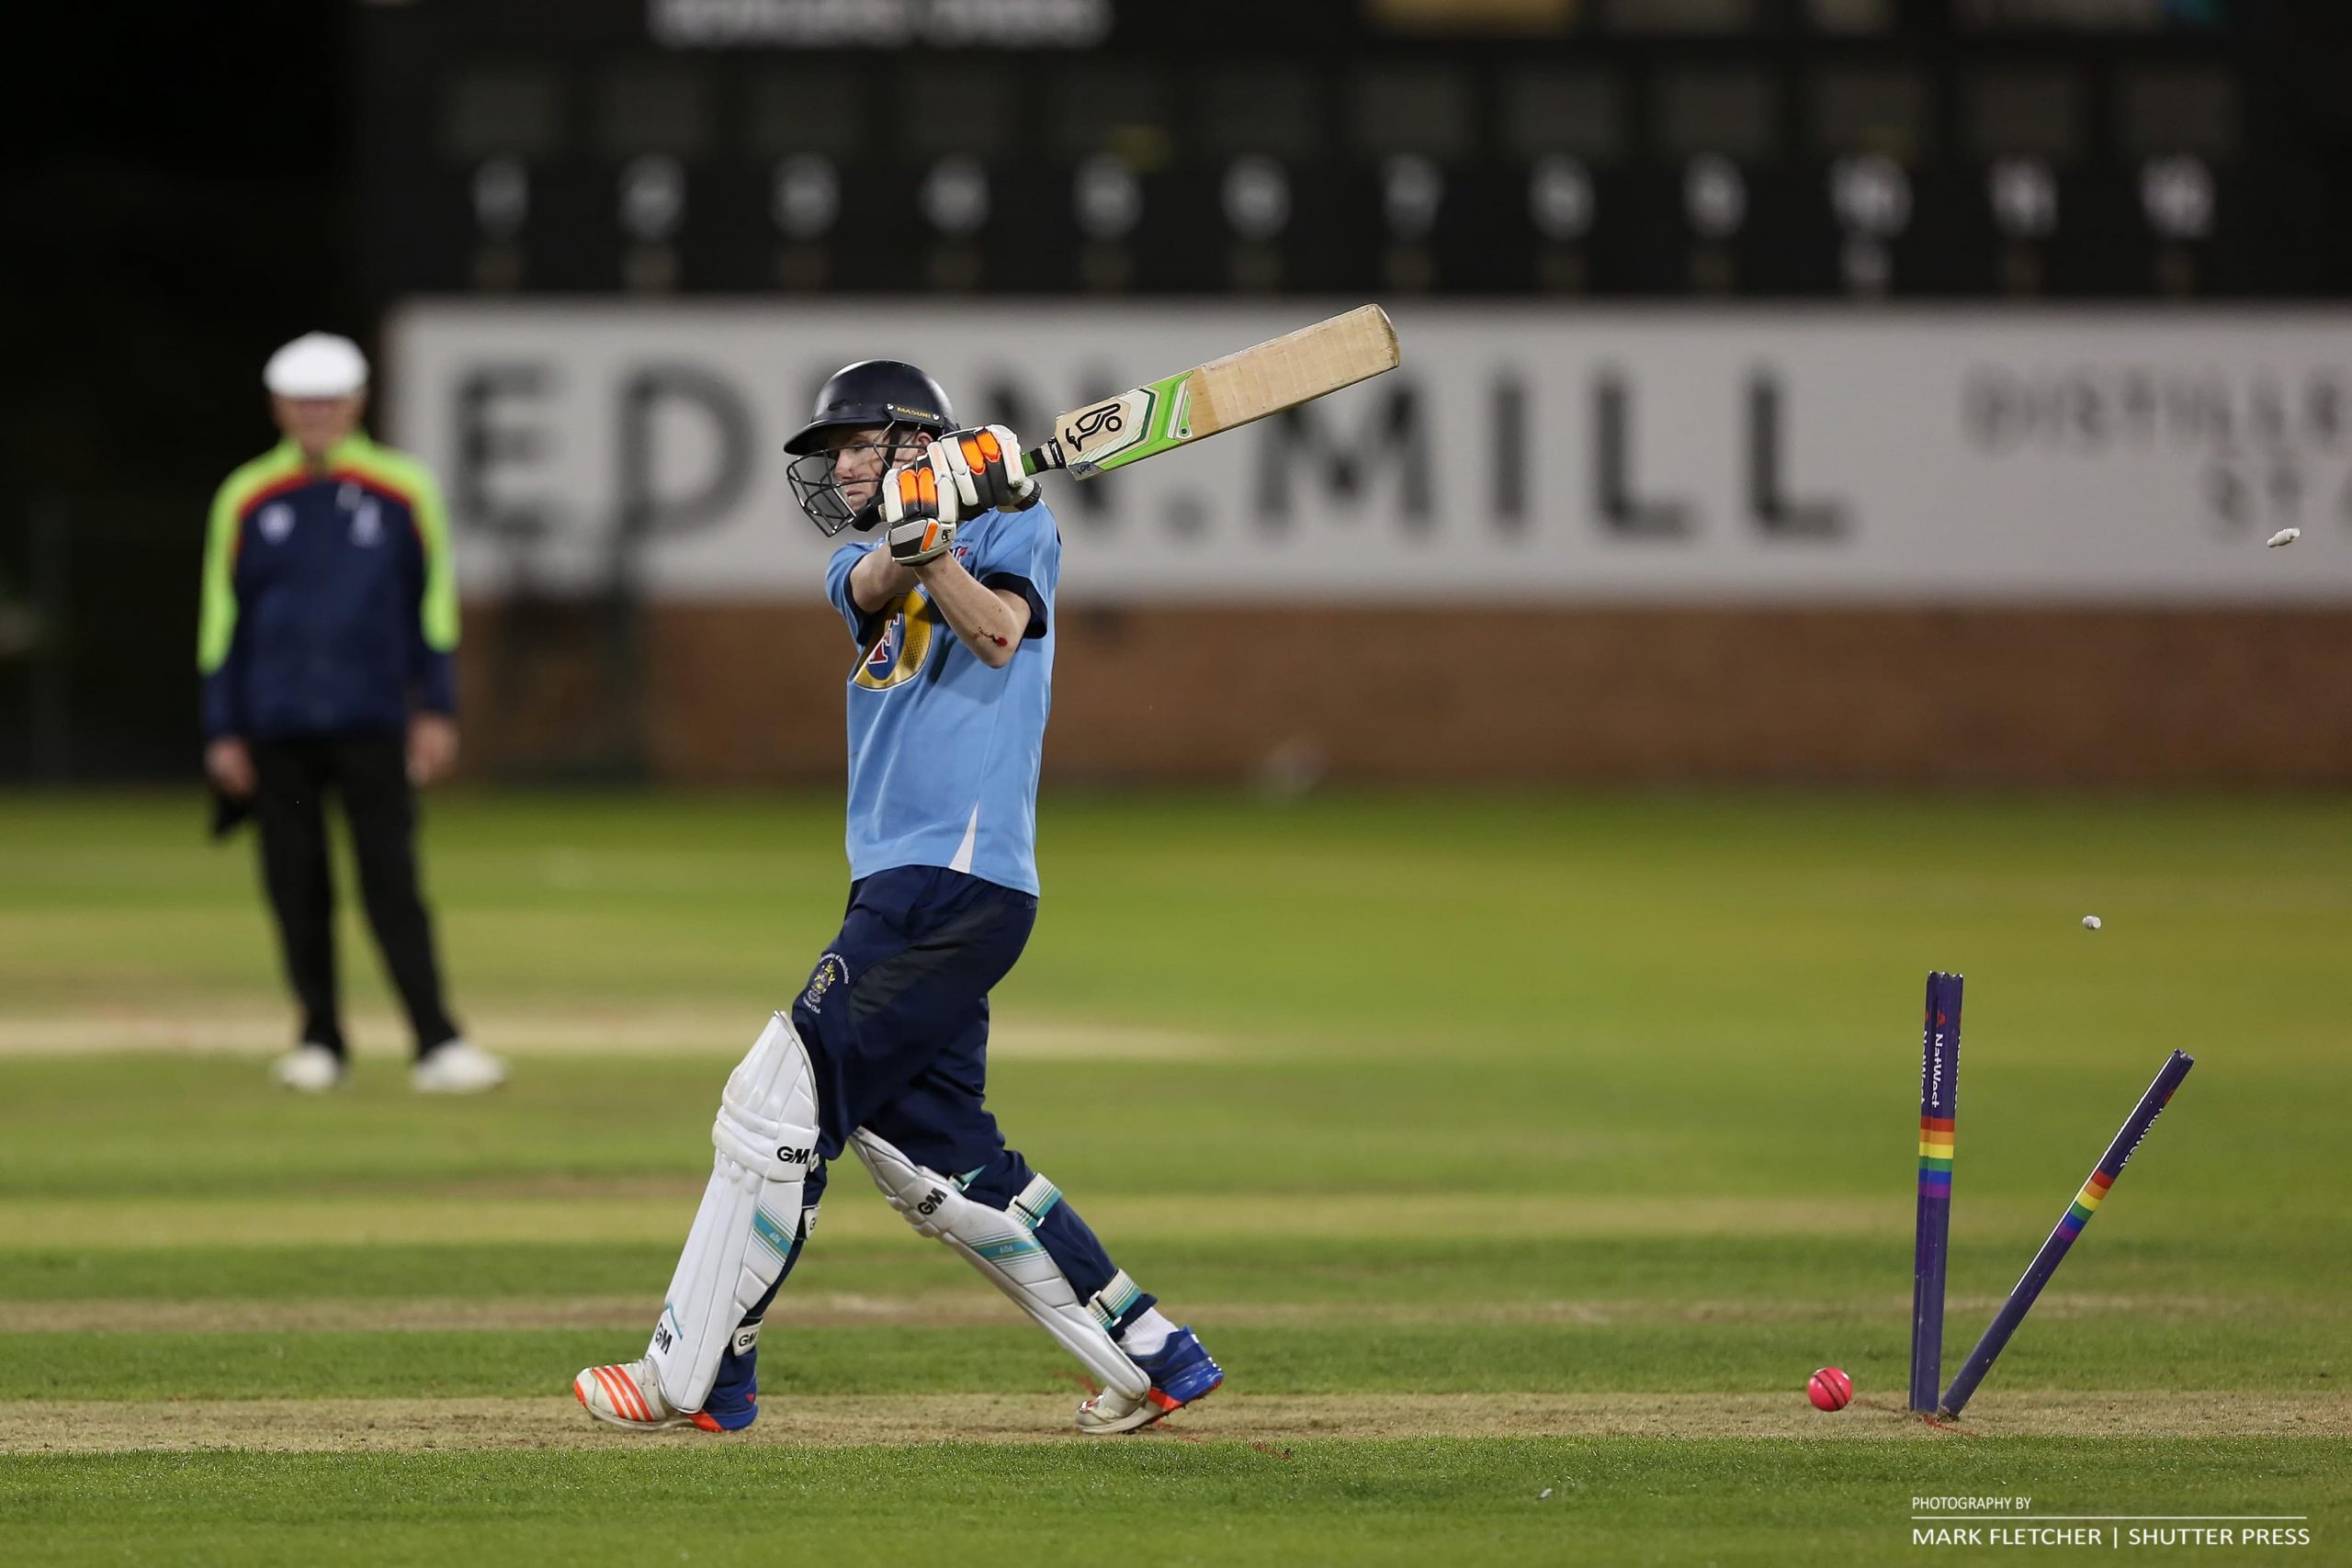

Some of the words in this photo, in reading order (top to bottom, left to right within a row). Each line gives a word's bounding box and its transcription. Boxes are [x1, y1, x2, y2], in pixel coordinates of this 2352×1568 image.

[897, 407, 932, 418] MASURI
[1931, 1033, 1943, 1108] NatWest
[776, 1145, 810, 1164] GM
[918, 1188, 948, 1214] GM
